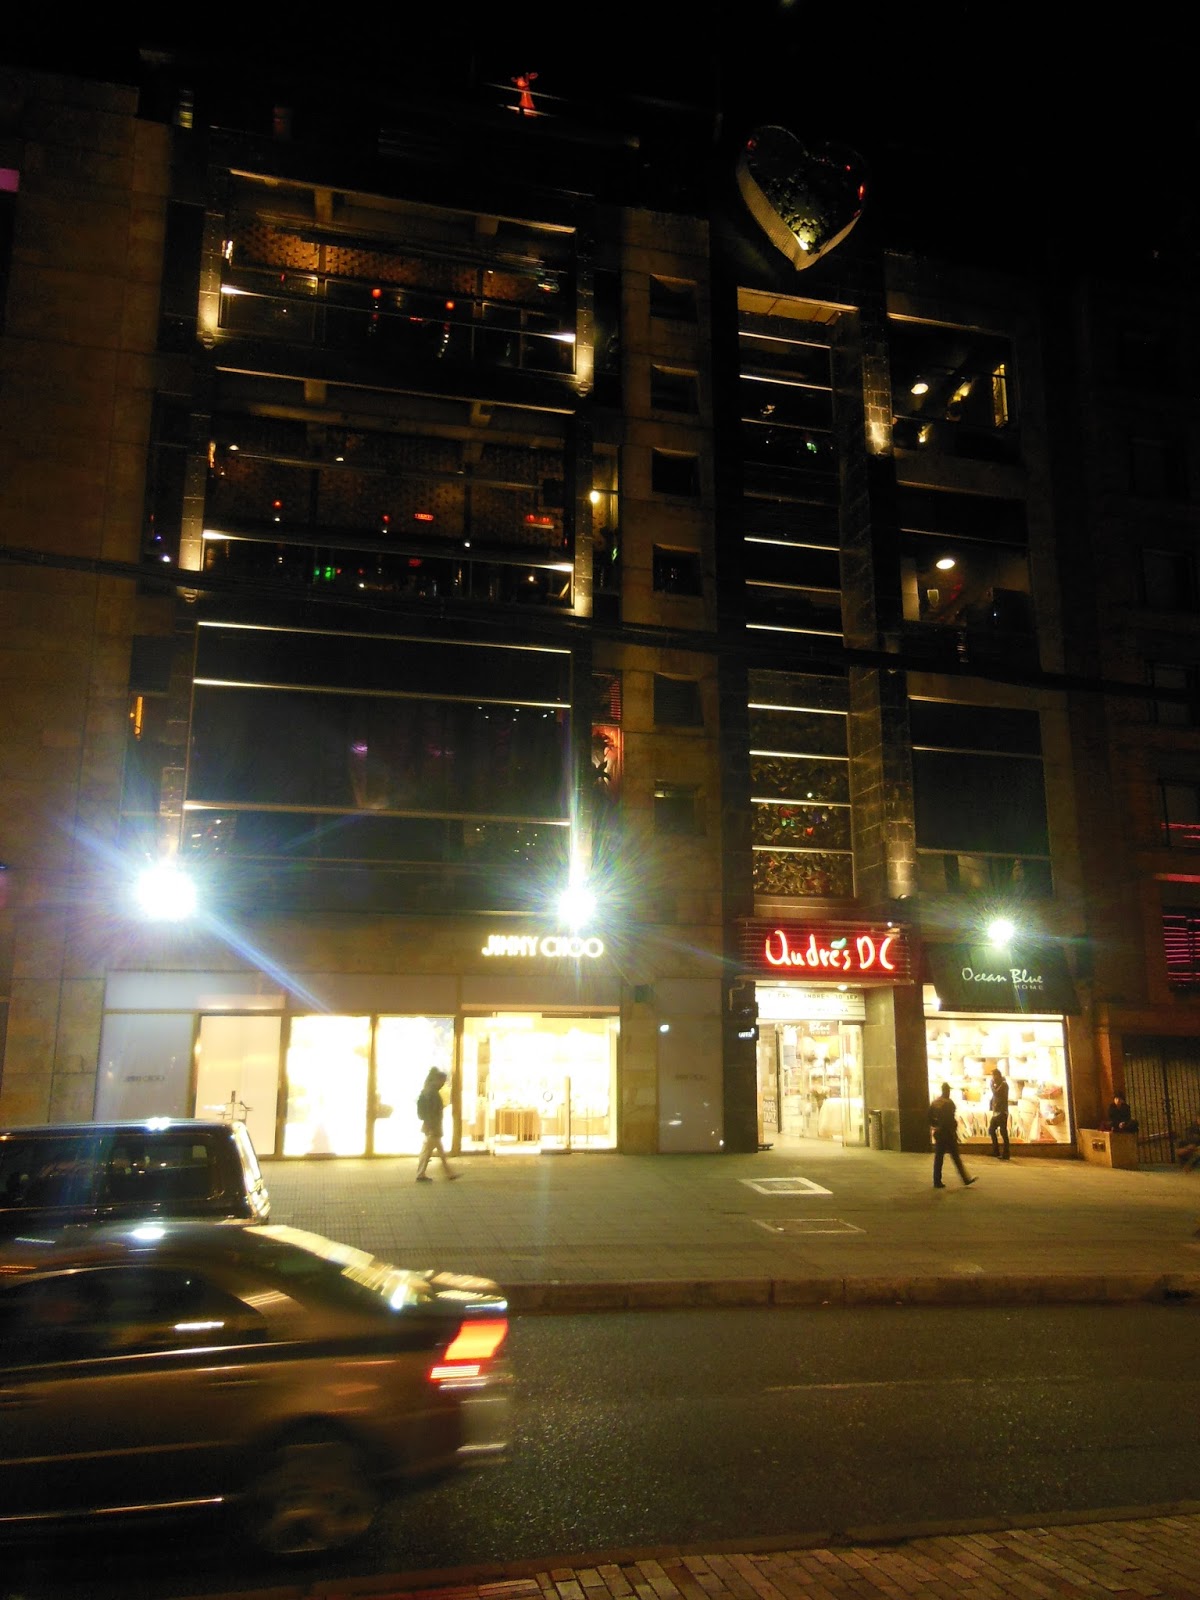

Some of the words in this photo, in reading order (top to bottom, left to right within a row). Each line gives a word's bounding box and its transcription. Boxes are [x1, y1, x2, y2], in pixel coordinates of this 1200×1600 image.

[482, 934, 539, 957] JIMMY
[540, 936, 604, 958] CHOO
[856, 935, 895, 970] DC
[961, 967, 1007, 982] Ocean
[1009, 968, 1044, 984] Blue
